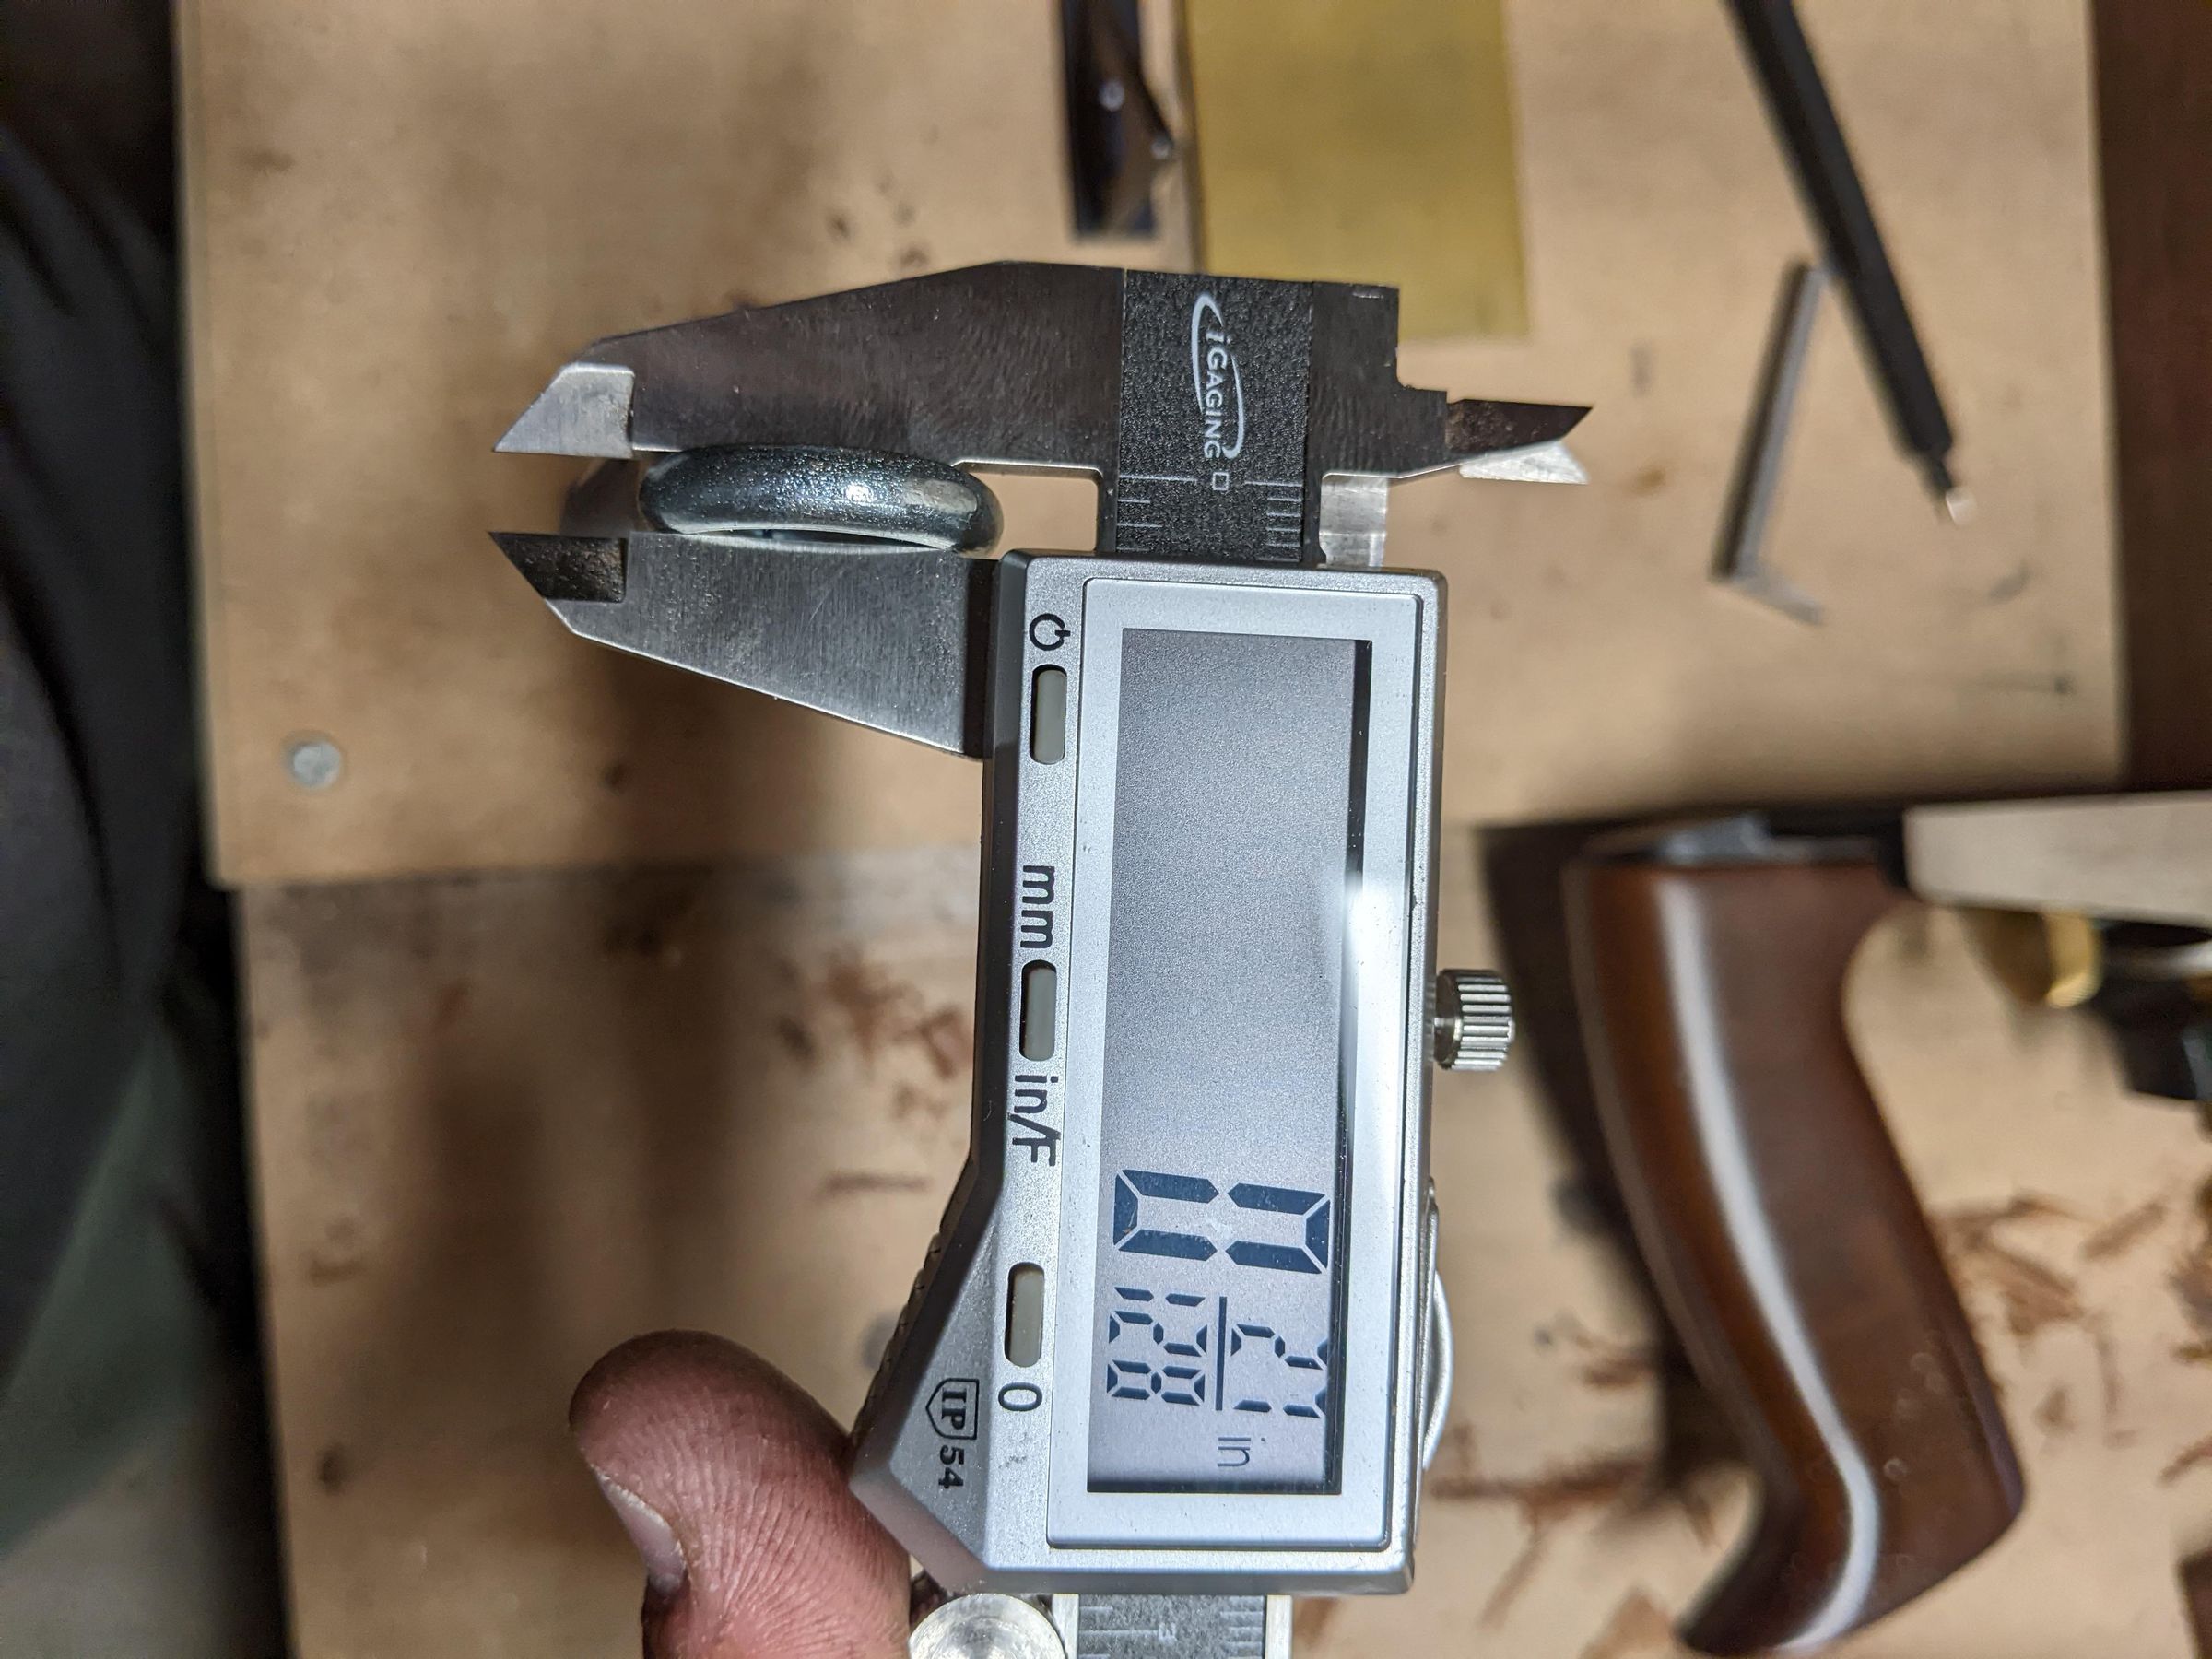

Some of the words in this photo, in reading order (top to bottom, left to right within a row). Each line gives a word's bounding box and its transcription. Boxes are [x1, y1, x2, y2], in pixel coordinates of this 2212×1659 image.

[1203, 330, 1231, 459] iGAGING
[1020, 865, 1055, 949] mm
[1007, 1074, 1061, 1168] in/F
[1112, 1169, 1330, 1275] 0
[1106, 1287, 1207, 1406] 128
[941, 1388, 967, 1430] IP
[998, 1382, 1043, 1412] 0
[938, 1444, 965, 1489] 54
[1217, 1437, 1266, 1467] in
